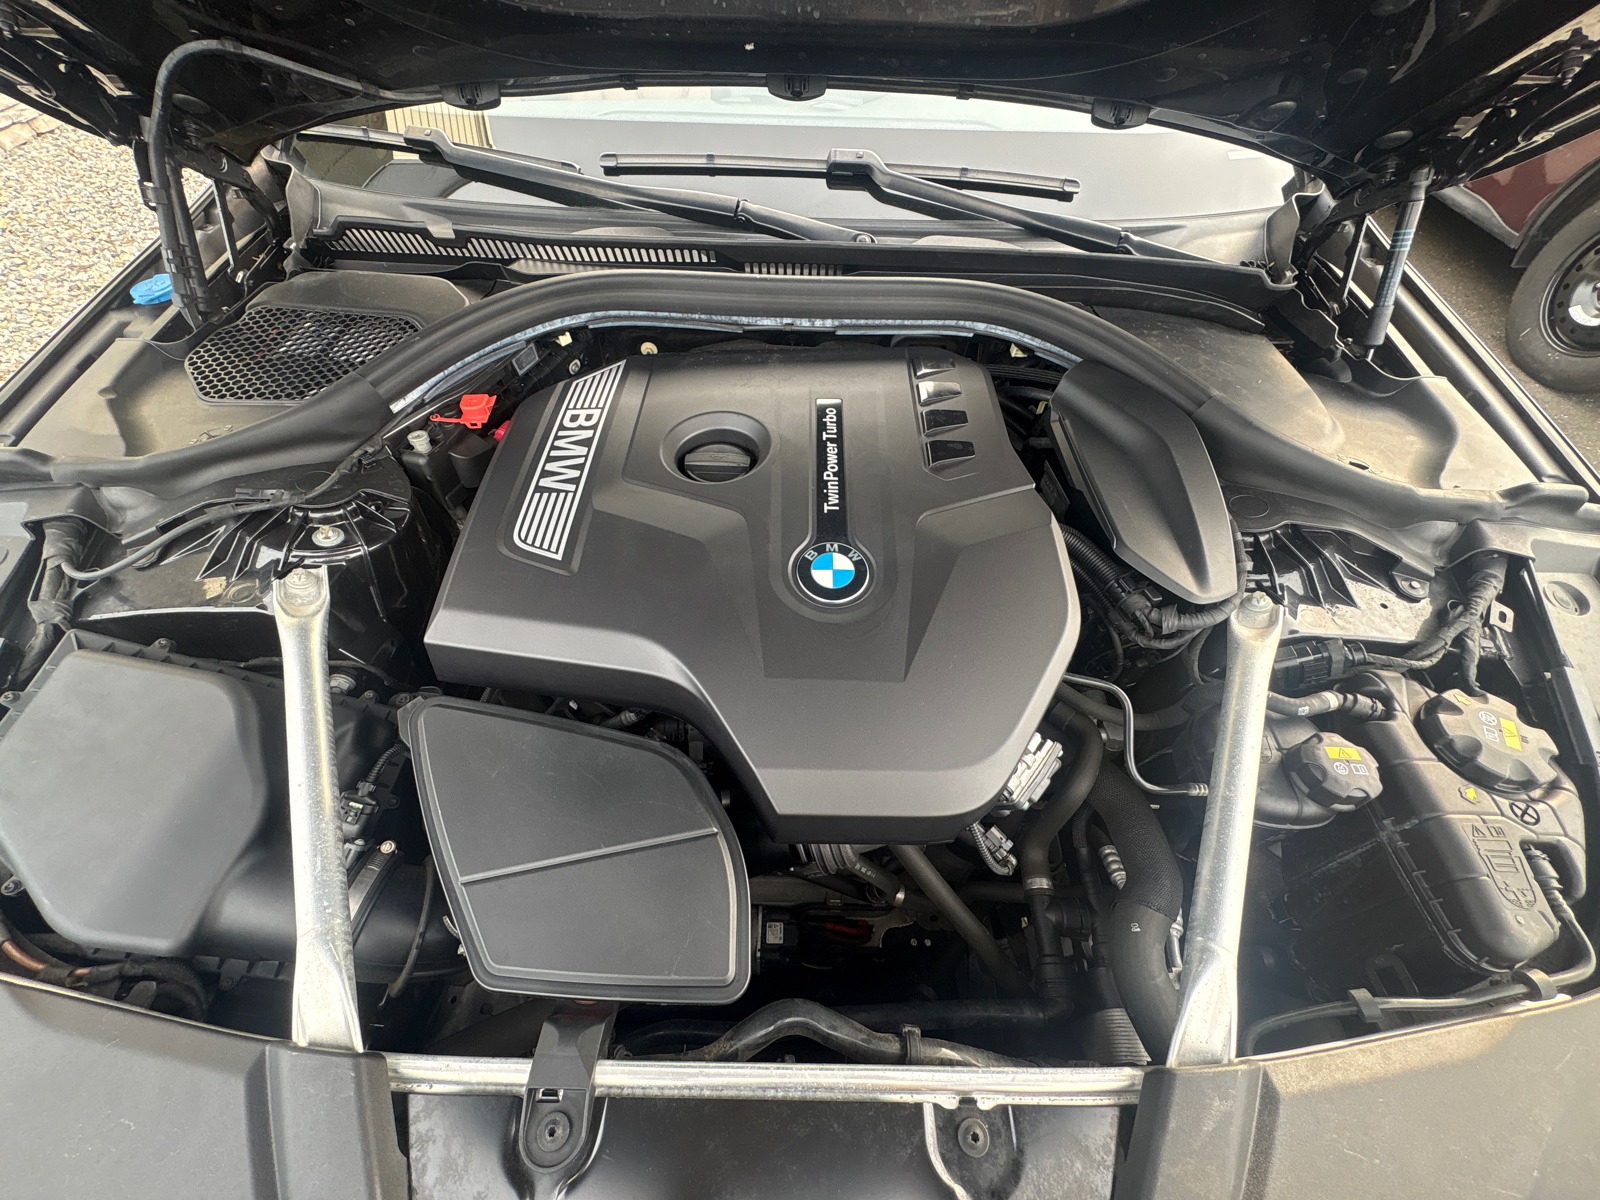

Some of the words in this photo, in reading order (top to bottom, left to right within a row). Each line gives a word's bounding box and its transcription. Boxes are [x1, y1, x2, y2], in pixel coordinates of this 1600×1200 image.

[538, 408, 602, 492] BMW
[822, 407, 838, 441] Turbo
[823, 441, 840, 514] TwinPower
[804, 543, 862, 562] BMW
